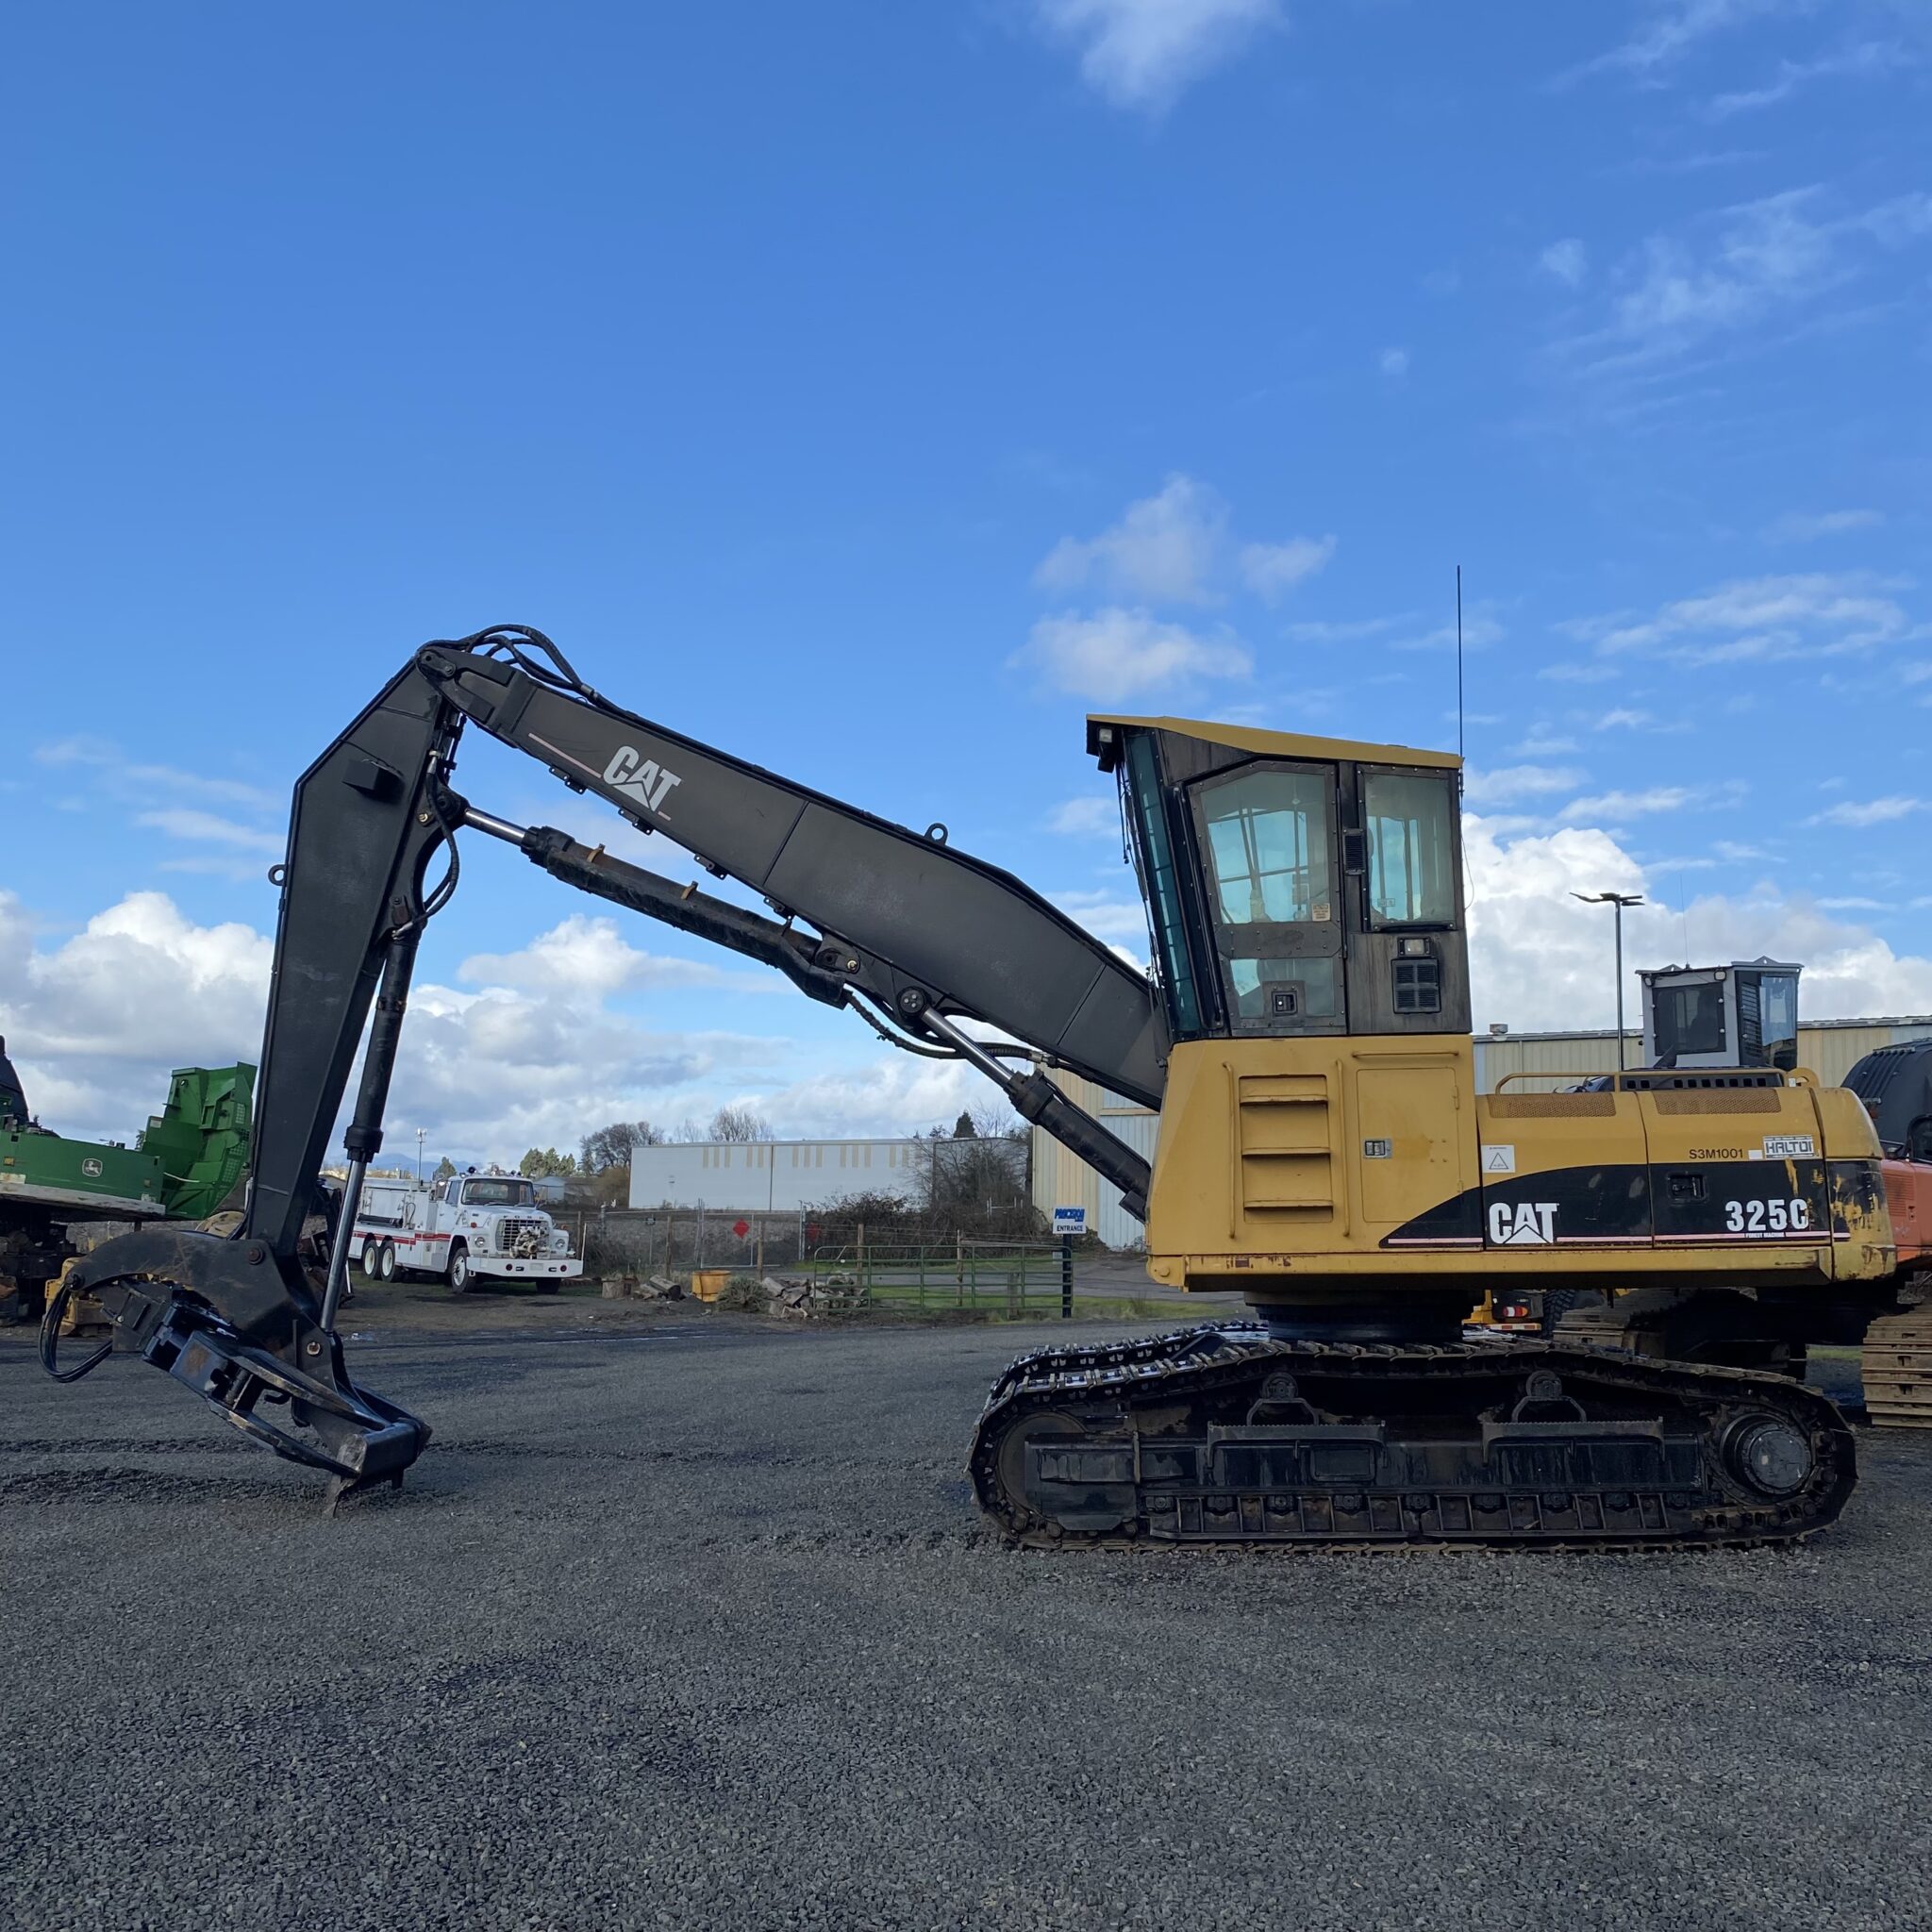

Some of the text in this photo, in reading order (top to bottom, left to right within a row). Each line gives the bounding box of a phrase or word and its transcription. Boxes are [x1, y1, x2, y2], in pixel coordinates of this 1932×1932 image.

[603, 745, 682, 812] CAT
[1689, 1148, 1743, 1159] S3M1001
[1489, 1202, 1557, 1244] CAT
[1724, 1198, 1809, 1232] 325C
